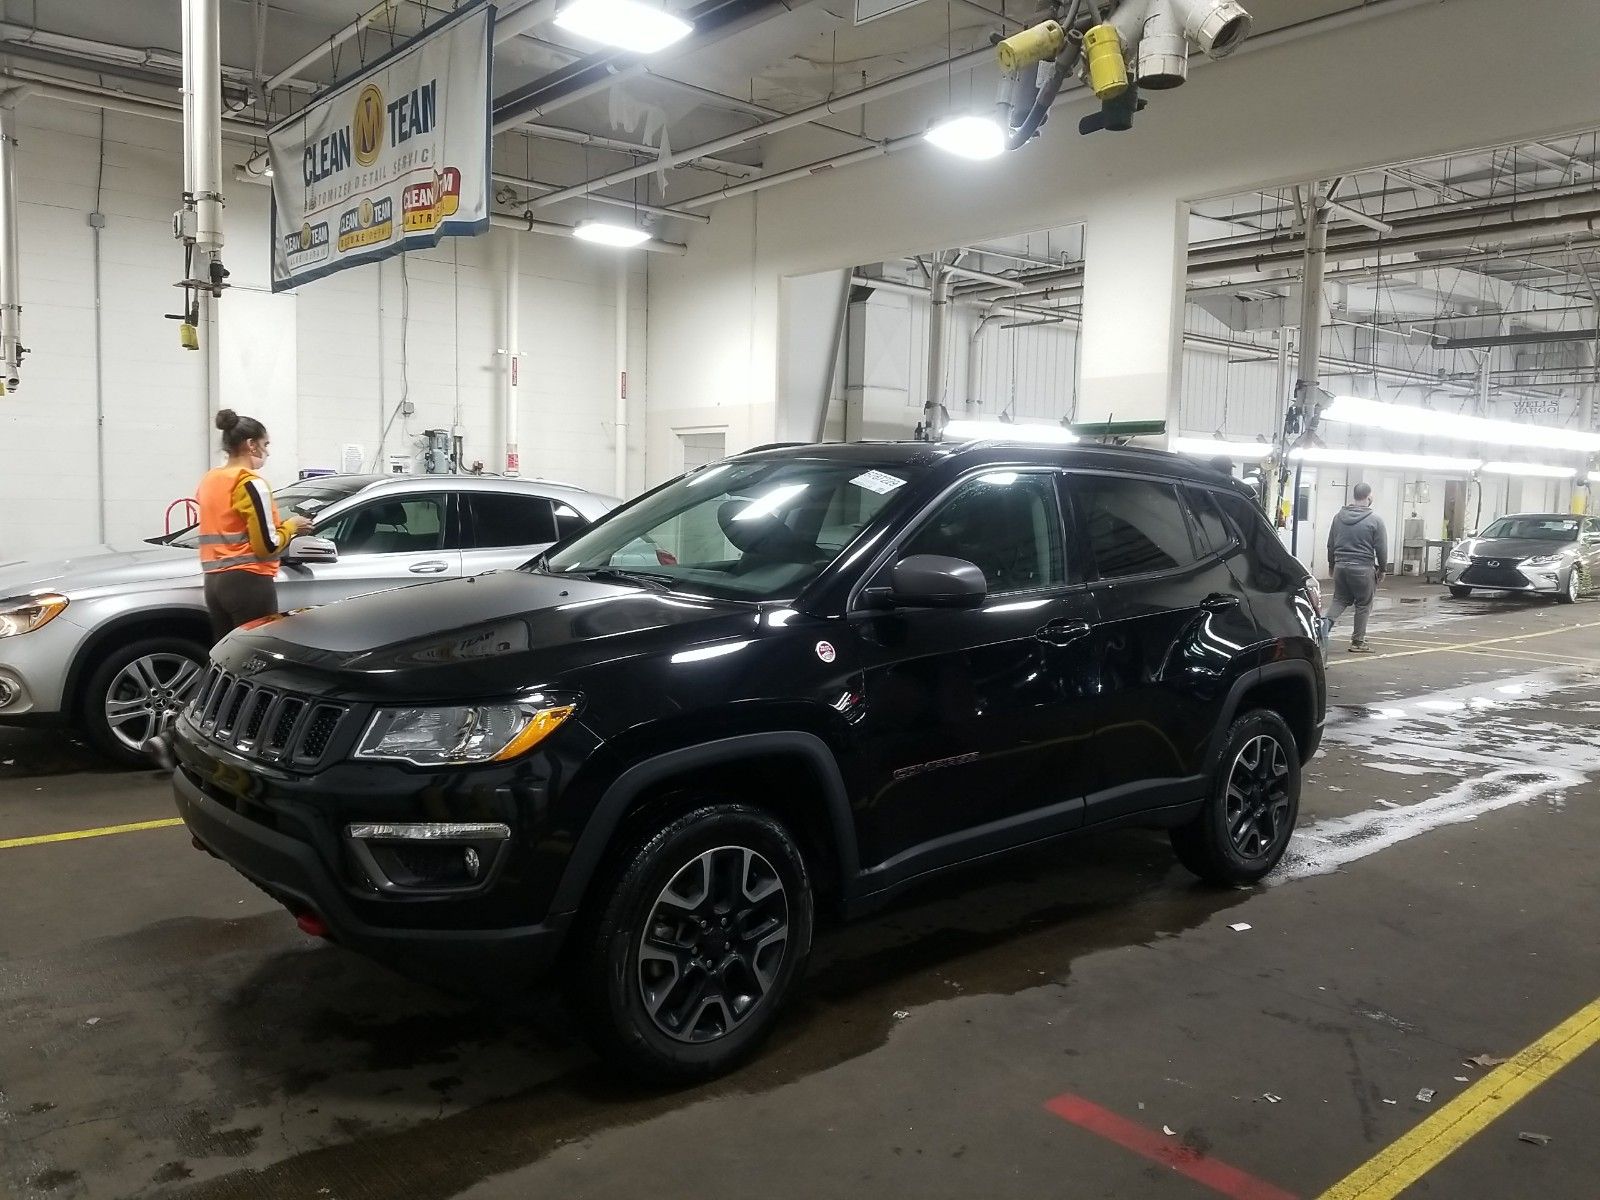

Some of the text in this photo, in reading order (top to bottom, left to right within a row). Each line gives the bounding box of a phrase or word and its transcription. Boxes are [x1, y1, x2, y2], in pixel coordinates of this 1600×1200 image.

[303, 125, 351, 187] CLEAN
[304, 143, 435, 212] TOMIZED DETAIL SERVIC
[403, 187, 434, 210] CLEAN
[374, 200, 391, 223] TEAM
[312, 225, 328, 246] TEAM
[1513, 400, 1559, 408] WELLS
